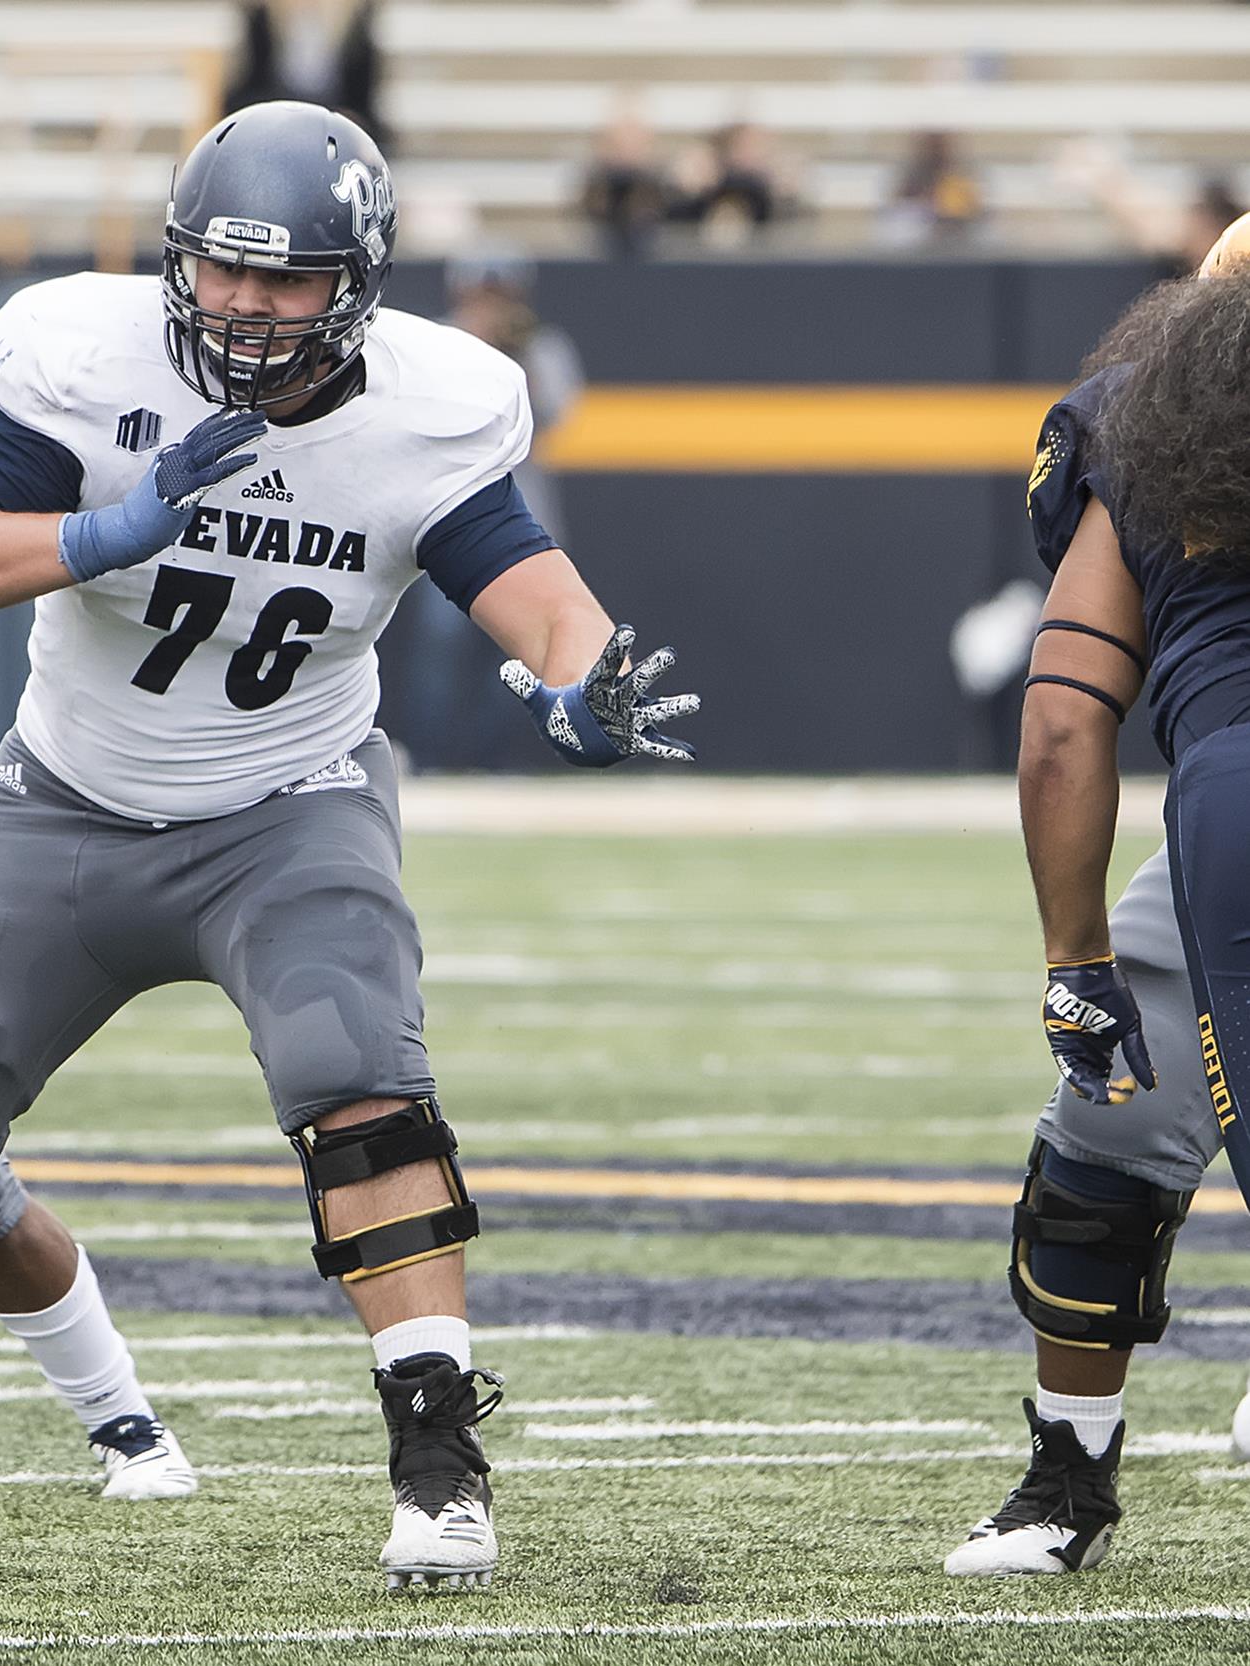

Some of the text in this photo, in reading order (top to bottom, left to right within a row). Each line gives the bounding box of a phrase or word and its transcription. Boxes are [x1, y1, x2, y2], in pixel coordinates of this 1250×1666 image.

[227, 222, 269, 243] NEVADA
[241, 486, 294, 503] adidas
[180, 505, 366, 573] EVADA
[130, 564, 334, 711] 76
[1046, 982, 1118, 1034] TOLEDO
[1197, 1012, 1237, 1136] TOLEDO
